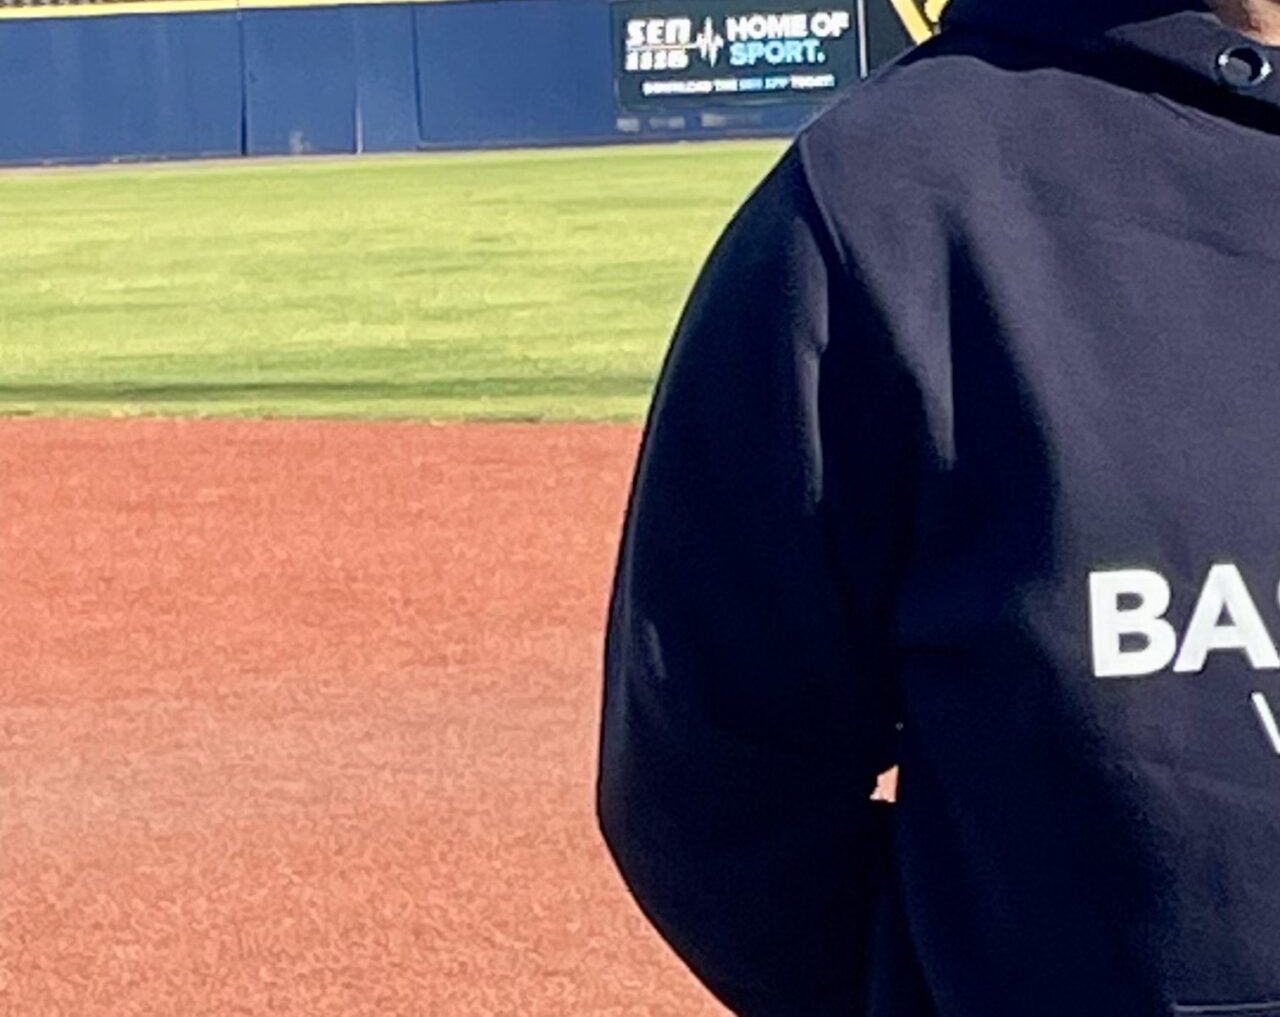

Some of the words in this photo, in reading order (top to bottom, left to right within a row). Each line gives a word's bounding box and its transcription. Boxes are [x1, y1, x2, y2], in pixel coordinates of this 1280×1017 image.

[726, 14, 807, 41] HOME
[810, 11, 849, 37] OF
[729, 39, 826, 66] SPORT.
